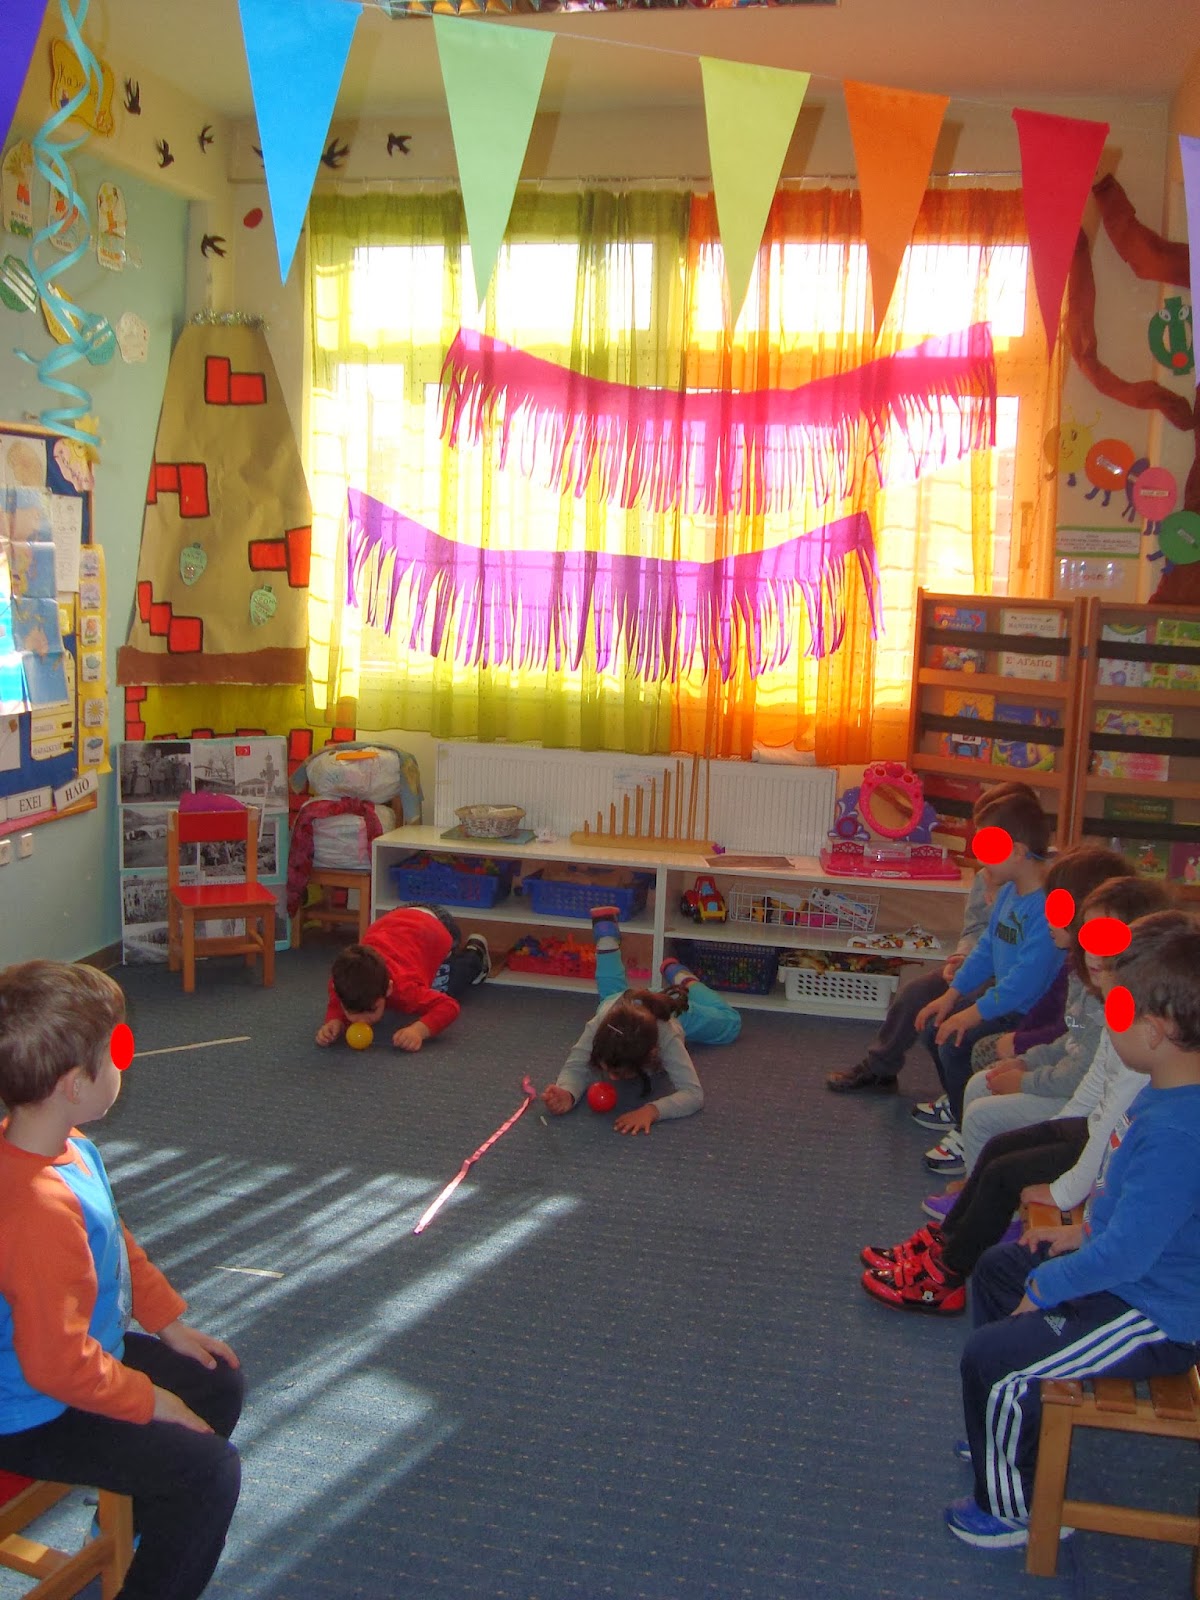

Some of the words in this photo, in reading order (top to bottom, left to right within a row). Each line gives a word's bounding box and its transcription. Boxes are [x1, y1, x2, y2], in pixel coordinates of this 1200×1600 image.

[1017, 657, 1053, 668] ΑΓΑΠΩ
[65, 777, 91, 802] ΗΛΙΟ
[19, 794, 42, 813] ΕΧΕΙ
